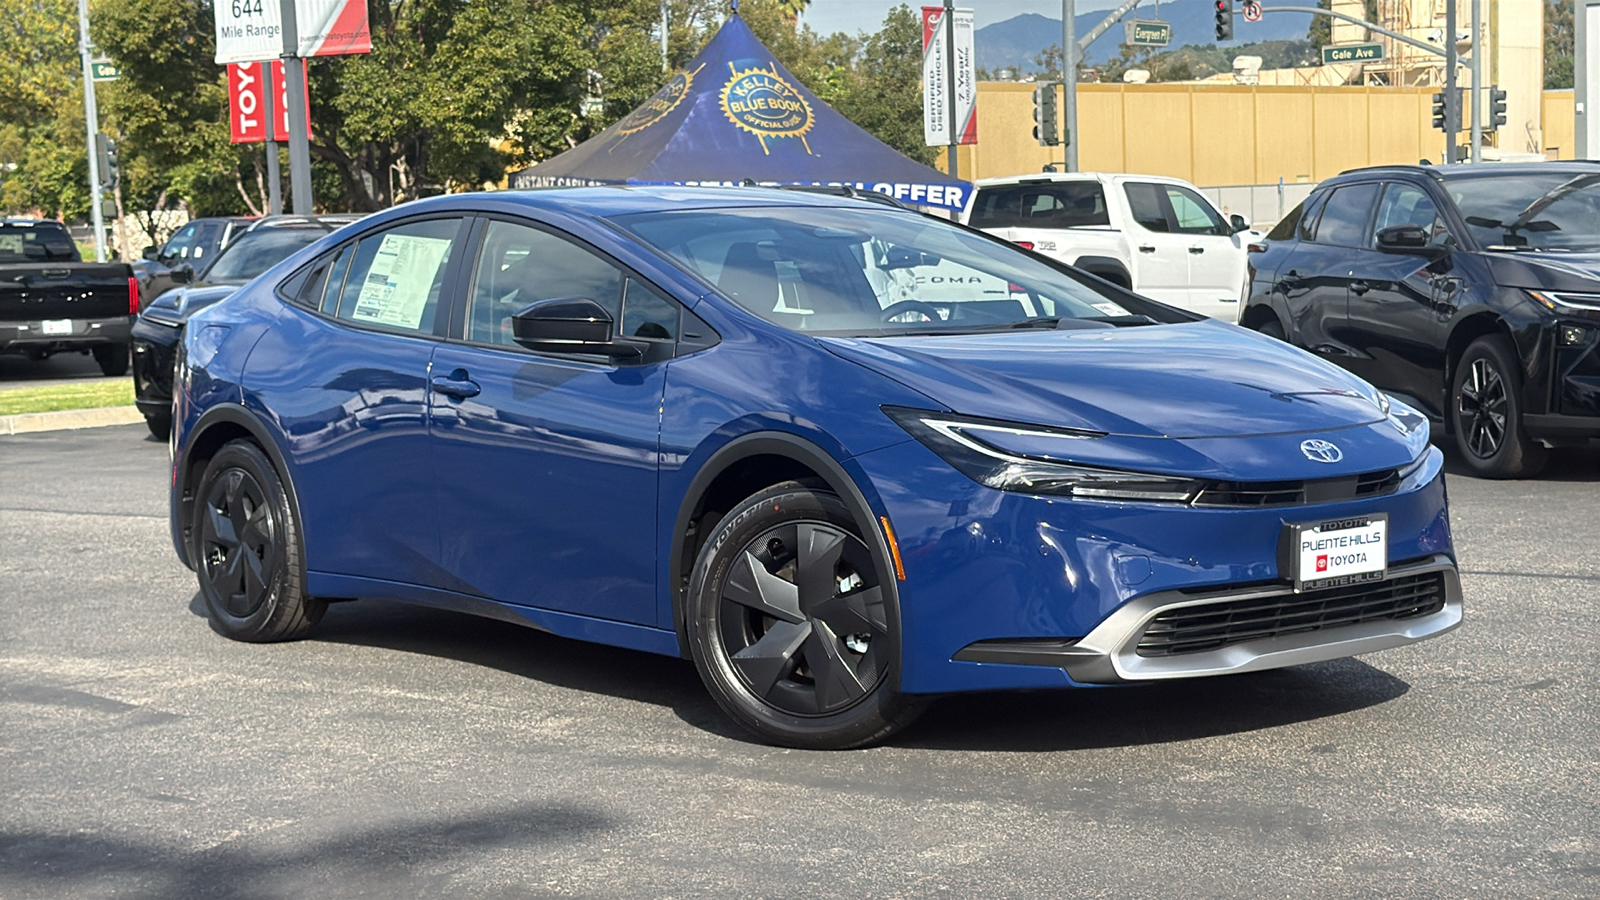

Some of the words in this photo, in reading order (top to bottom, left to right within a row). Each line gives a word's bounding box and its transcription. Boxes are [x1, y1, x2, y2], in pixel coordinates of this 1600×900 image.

[232, 0, 263, 18] 644
[221, 25, 243, 38] Mile
[246, 24, 280, 38] Range
[1135, 27, 1160, 42] Evergreen
[1331, 50, 1352, 60] Gale
[1355, 48, 1374, 58] Ave
[935, 39, 943, 96] VEHICLES
[733, 77, 793, 97] KELLEY
[958, 93, 965, 101] 7
[730, 98, 768, 113] BLUE
[767, 98, 804, 113] BOOK
[744, 114, 784, 128] OFFICIAL
[872, 183, 963, 208] OFFER
[1322, 518, 1368, 530] TOYOTA
[1302, 536, 1348, 552] PUENTE
[1349, 532, 1381, 546] HILLS
[1330, 552, 1367, 567] TOYOTA
[1303, 576, 1348, 590] PUENTE
[1349, 572, 1382, 584] HILLS
